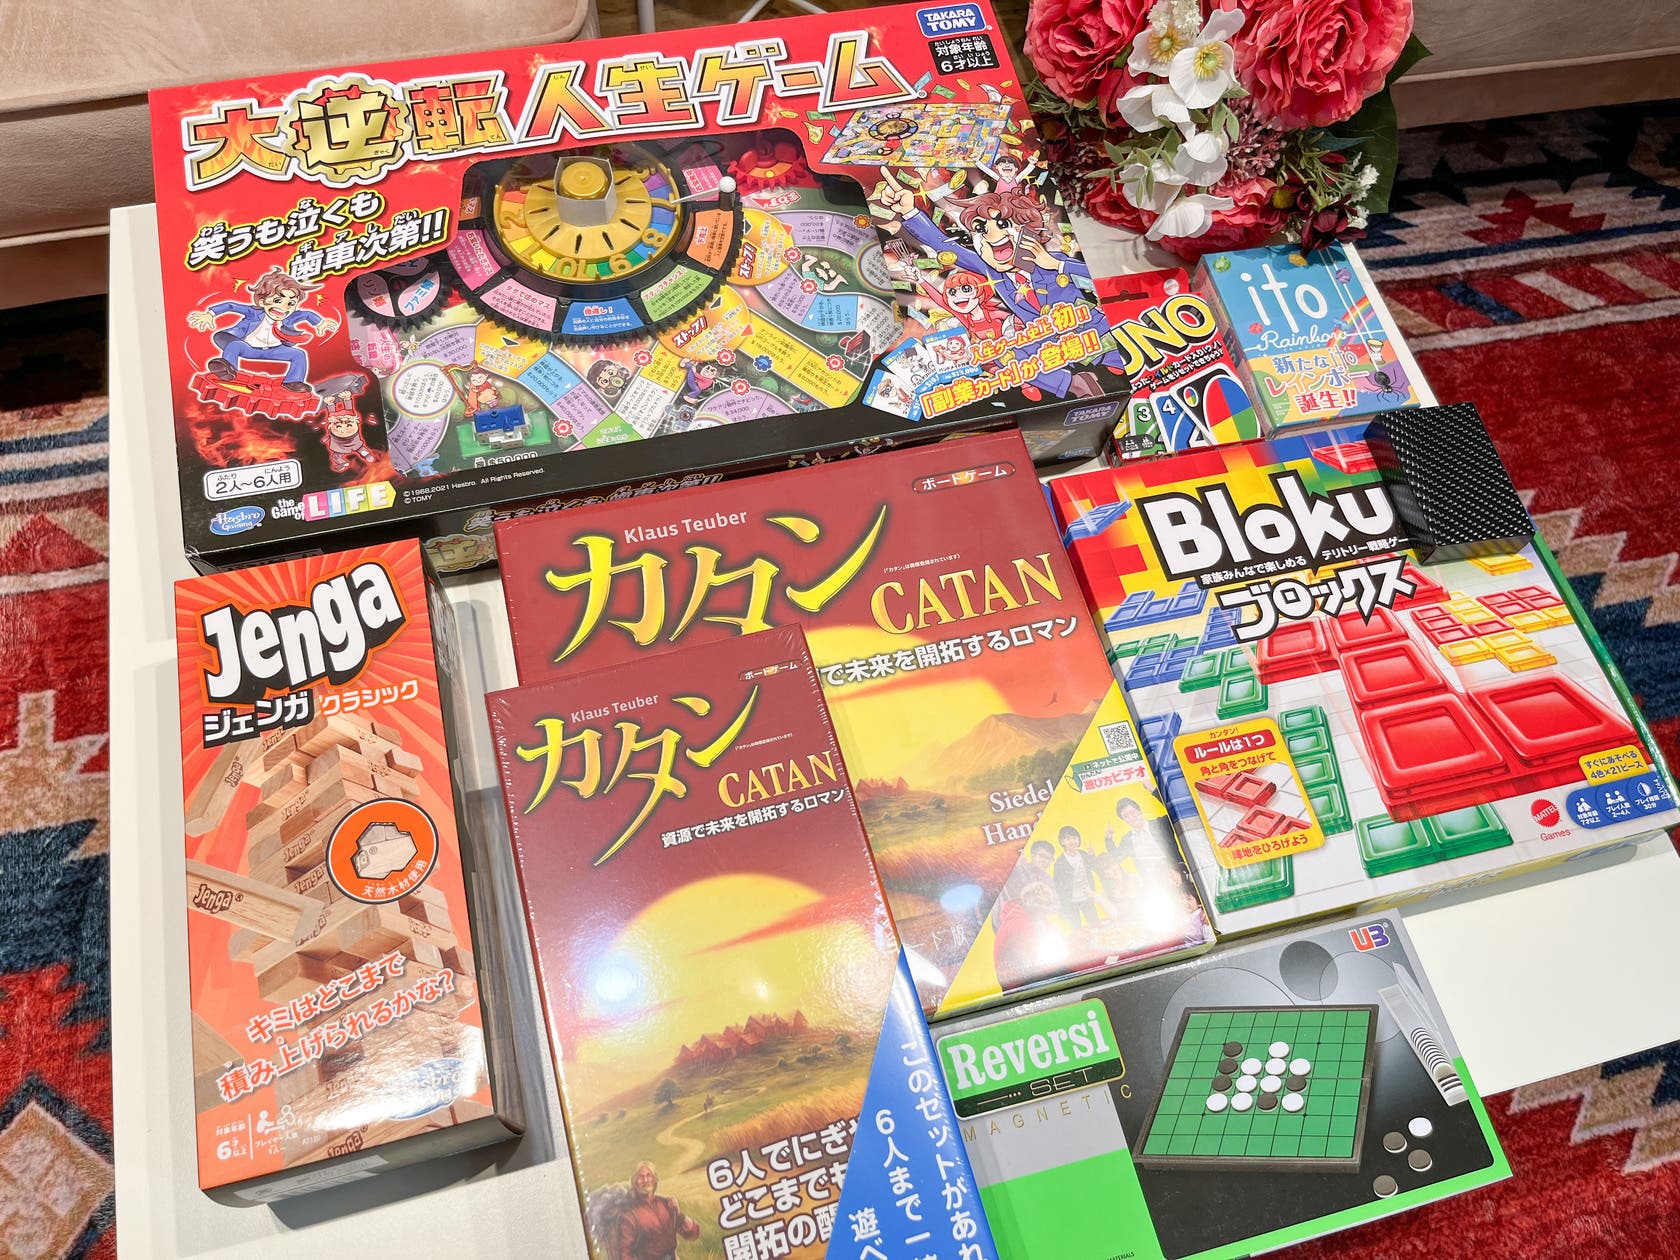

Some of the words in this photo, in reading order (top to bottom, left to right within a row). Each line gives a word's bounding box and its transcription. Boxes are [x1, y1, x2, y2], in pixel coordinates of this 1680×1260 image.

[924, 8, 975, 22] TAKARA
[927, 17, 976, 32] TOMY
[936, 41, 988, 57] 対象年齢
[941, 56, 994, 73] 6才以上
[187, 33, 910, 190] 大逆転人生ゲーム
[188, 193, 380, 267] 笑うも泣くも
[289, 210, 445, 280] 歯車次第!!
[642, 228, 665, 247] 8
[1241, 263, 1328, 334] ito
[671, 315, 708, 349] ストップ!
[971, 304, 1091, 366] 人生ゲーム史上初!!
[1109, 295, 1217, 375] UNO
[1257, 325, 1347, 351] Rainbow
[922, 330, 1102, 418] 「副業カード」が登場!!
[1265, 366, 1369, 397] レインボー
[1137, 406, 1152, 422] 3
[1162, 399, 1177, 415] 4
[1295, 389, 1357, 415] 誕生!!
[920, 465, 1009, 490] ボードゲーム
[271, 502, 305, 520] Game
[277, 498, 296, 508] the
[295, 512, 305, 520] of
[308, 484, 389, 518] LIFE
[623, 516, 679, 545] Klaus
[681, 508, 749, 538] Teuber
[1143, 476, 1395, 576] Bloku
[1321, 537, 1409, 561] テリトリー戦略ゲー
[1200, 556, 1307, 586] 家族みんなで楽しめる
[869, 552, 1065, 636] CATAN
[1218, 558, 1415, 641] ブロックス
[203, 562, 403, 699] Jenga
[818, 614, 1078, 688] で未来を開拓するロマン
[744, 661, 799, 681] ボードゲーム
[320, 679, 420, 717] クラシック
[570, 700, 611, 724] Klaus
[612, 693, 660, 715] Teuber
[204, 692, 309, 743] ジェンガ
[1193, 733, 1266, 760] ルールは1つ
[1584, 750, 1639, 770] すぐにあそべる
[516, 685, 759, 867] カタン
[717, 750, 838, 808] CATAN
[1199, 751, 1277, 777] 角と角をつなげて
[660, 787, 847, 849] 資源で未来を開拓するロマン
[1532, 805, 1561, 824] MATTEL
[283, 832, 312, 863] Jenga
[1539, 827, 1572, 842] Games
[293, 866, 325, 895] Jenga
[193, 884, 237, 915] Jenga
[247, 951, 406, 1043] キミはどこまで
[217, 968, 455, 1102] 積み上げられるかな?
[946, 1009, 1110, 1091] Reversi
[1029, 1067, 1094, 1097] SET
[962, 1082, 1135, 1141] MAGNETIC
[874, 1108, 940, 1260] 6人まで一
